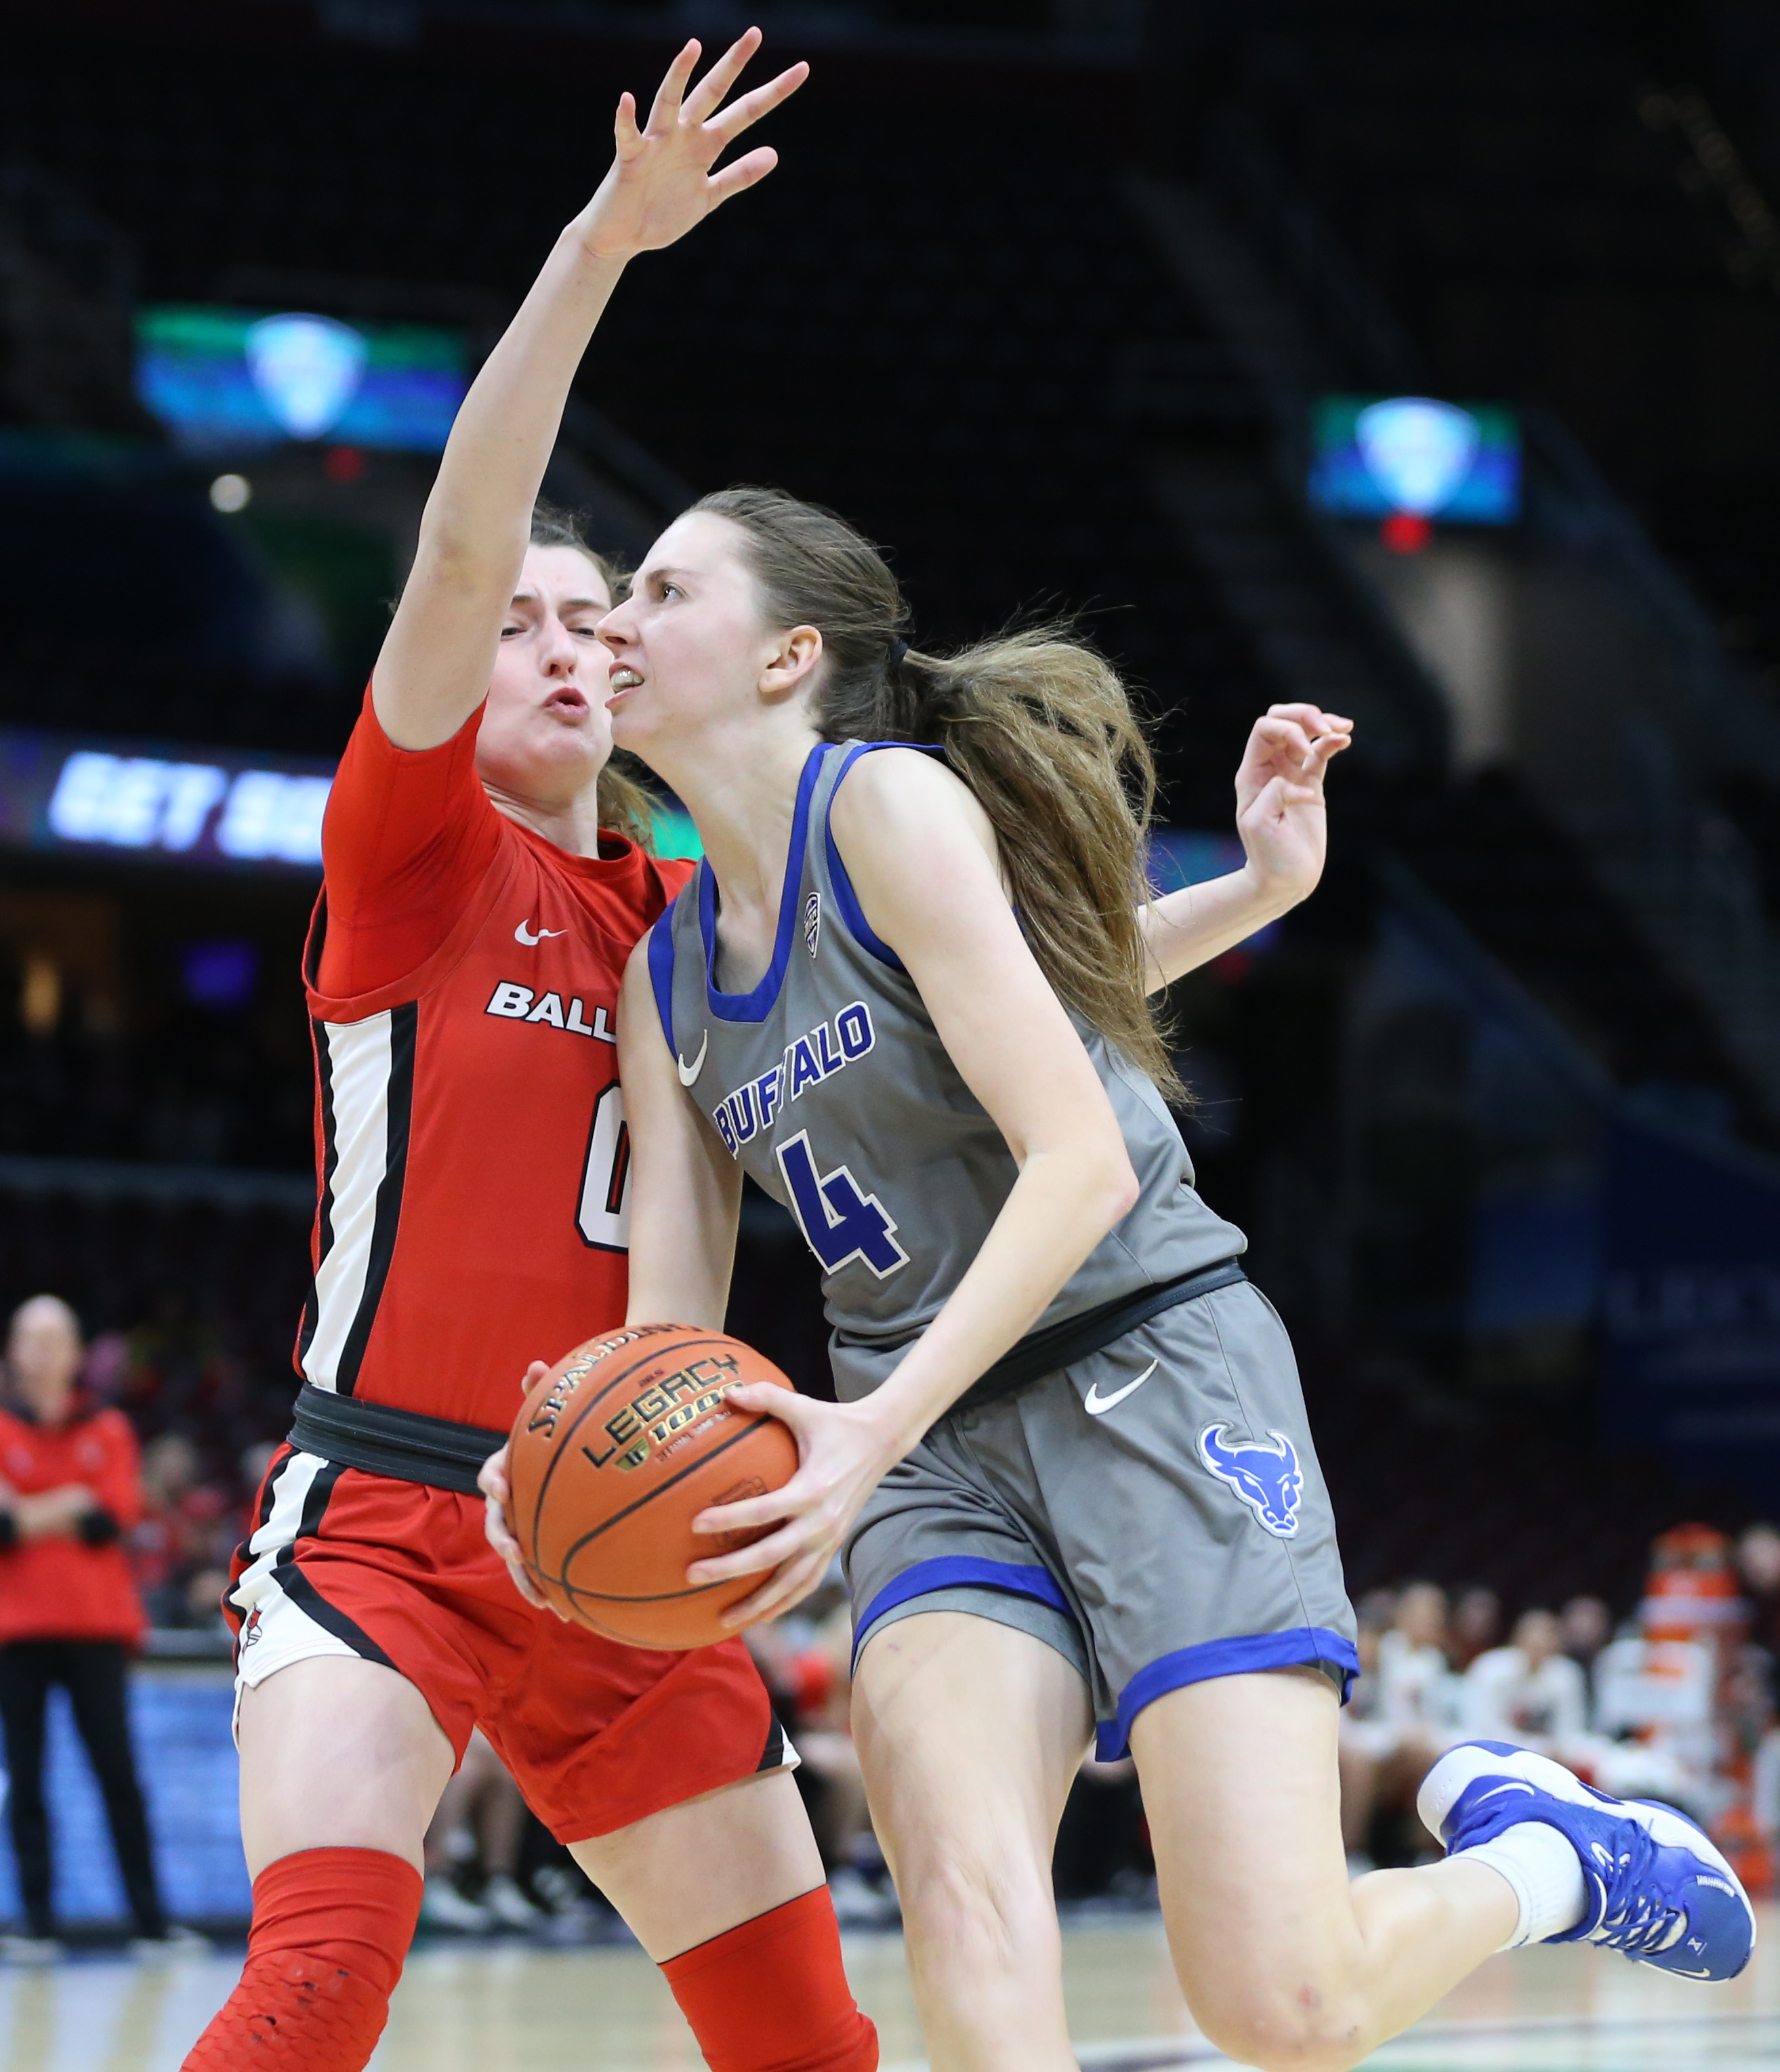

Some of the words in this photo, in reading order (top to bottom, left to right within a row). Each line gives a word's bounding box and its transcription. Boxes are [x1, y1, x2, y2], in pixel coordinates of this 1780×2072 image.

[484, 980, 617, 1045] BALL
[712, 1000, 876, 1160] BUFALO
[776, 1129, 910, 1279] 4
[581, 1353, 740, 1469] LEGACY
